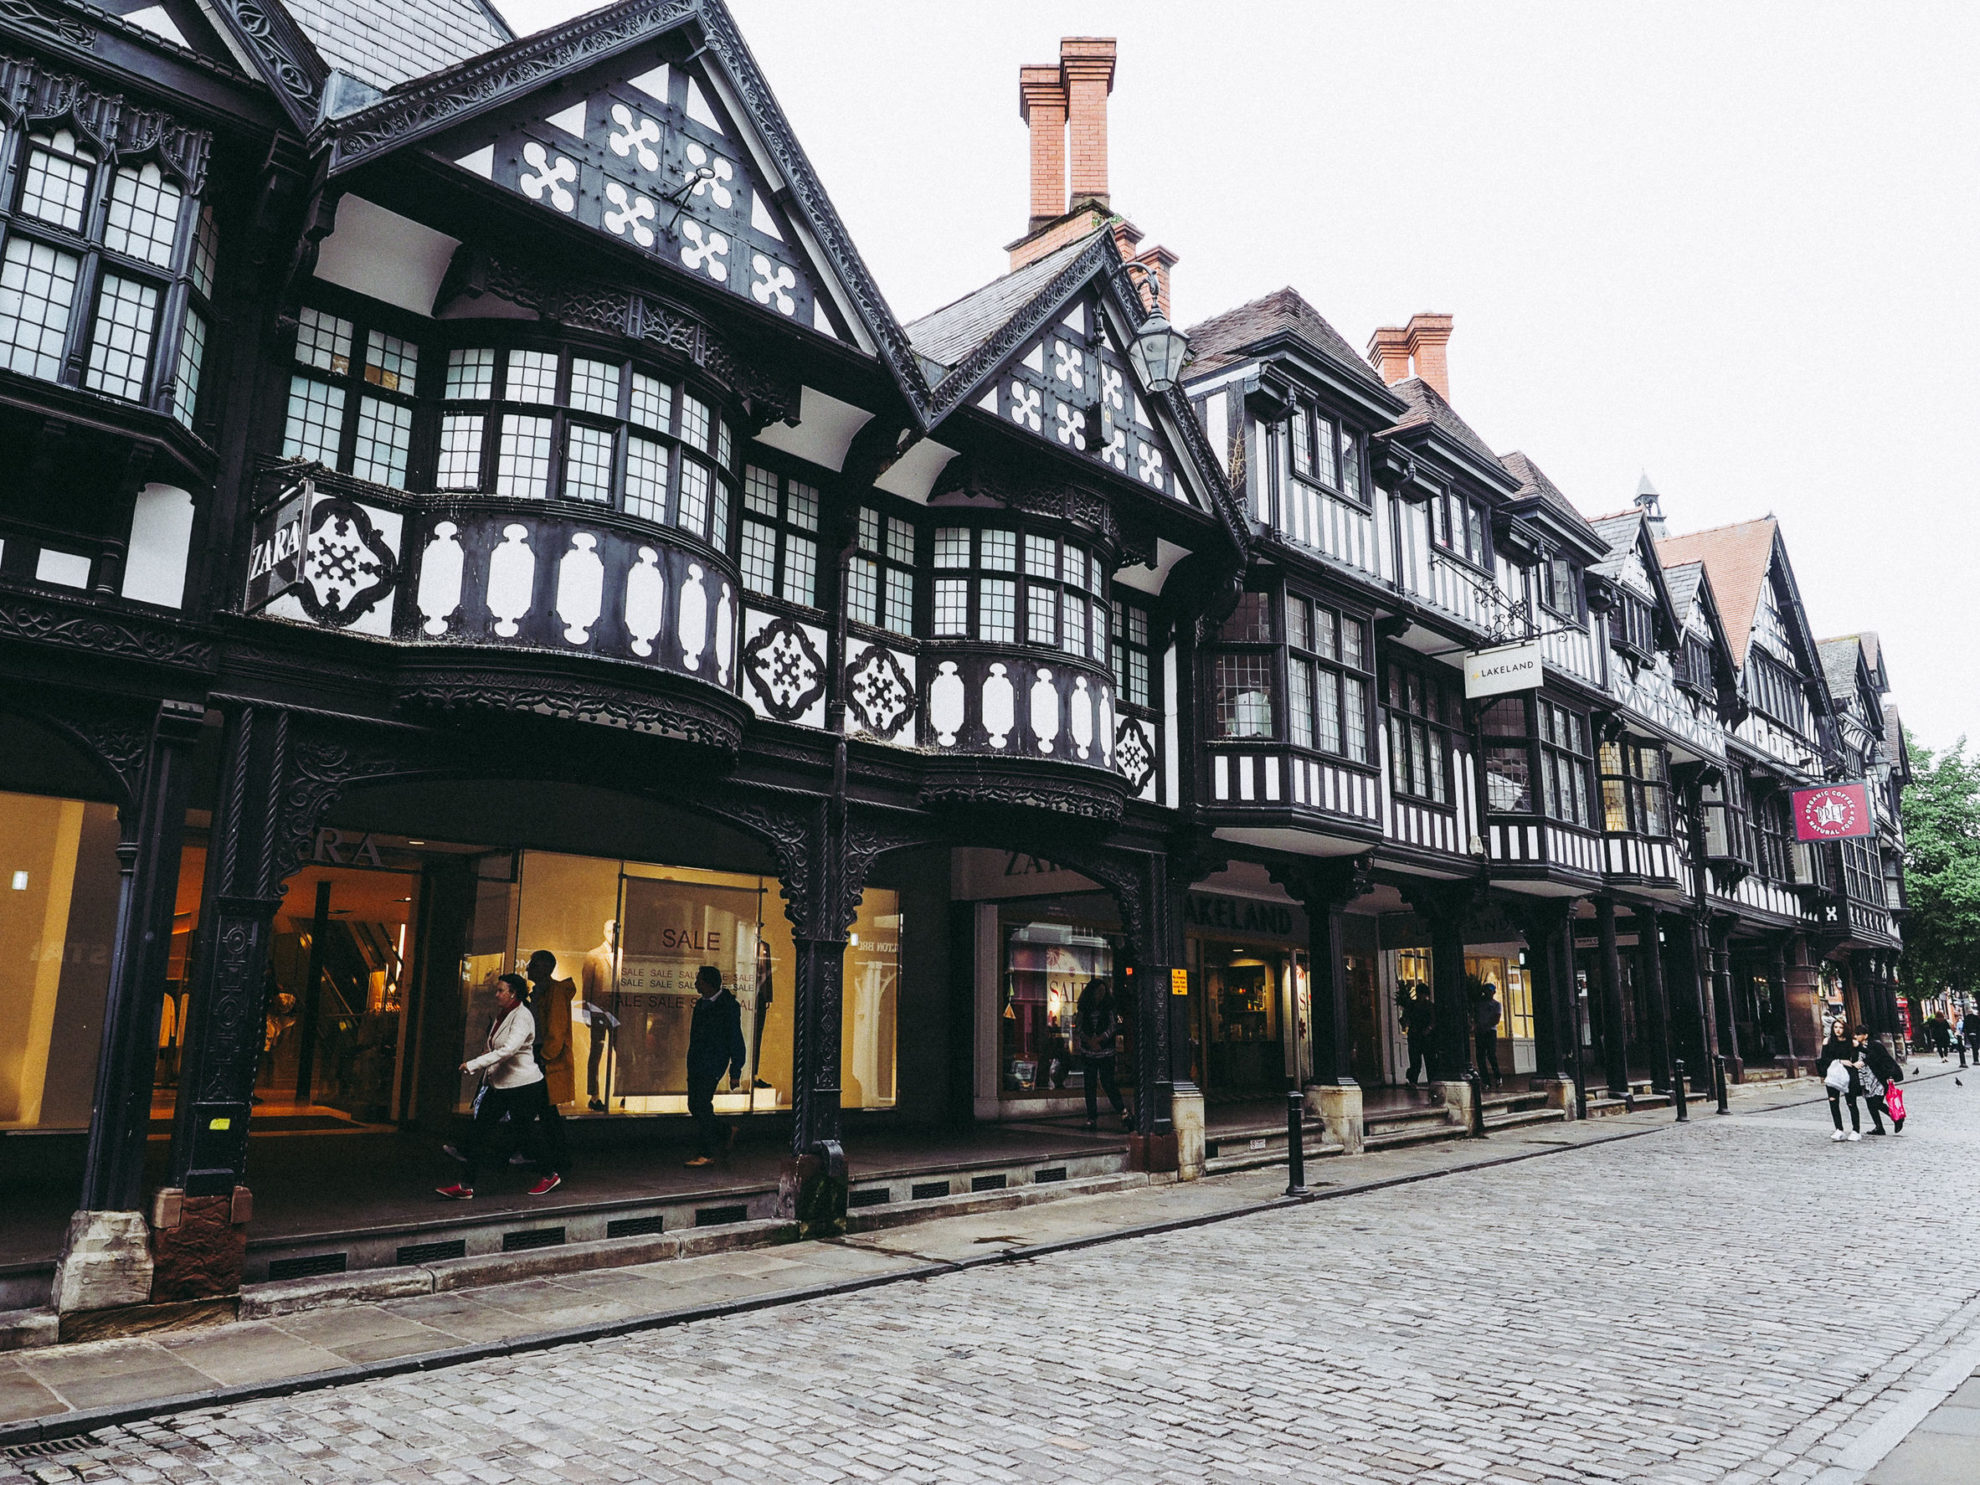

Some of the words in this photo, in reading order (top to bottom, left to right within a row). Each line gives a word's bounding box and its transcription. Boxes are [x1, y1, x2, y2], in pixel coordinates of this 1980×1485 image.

[250, 520, 300, 581] ZARA
[1481, 661, 1534, 678] LAKELAND
[1805, 790, 1829, 813] ORGANIC
[1831, 790, 1855, 808] COFFEE
[1817, 804, 1843, 821] PRET
[1809, 820, 1840, 835] NATURAL
[1841, 815, 1855, 832] FOOD
[662, 928, 721, 951] SALE
[621, 968, 644, 976] SALE
[650, 969, 673, 979] SALE
[679, 970, 698, 980] SAL
[733, 973, 754, 982] SALE
[621, 979, 643, 987] SALE
[650, 980, 672, 988] SALE
[678, 981, 696, 990] SAL
[733, 983, 754, 992] SALE
[648, 995, 684, 1009] SALE
